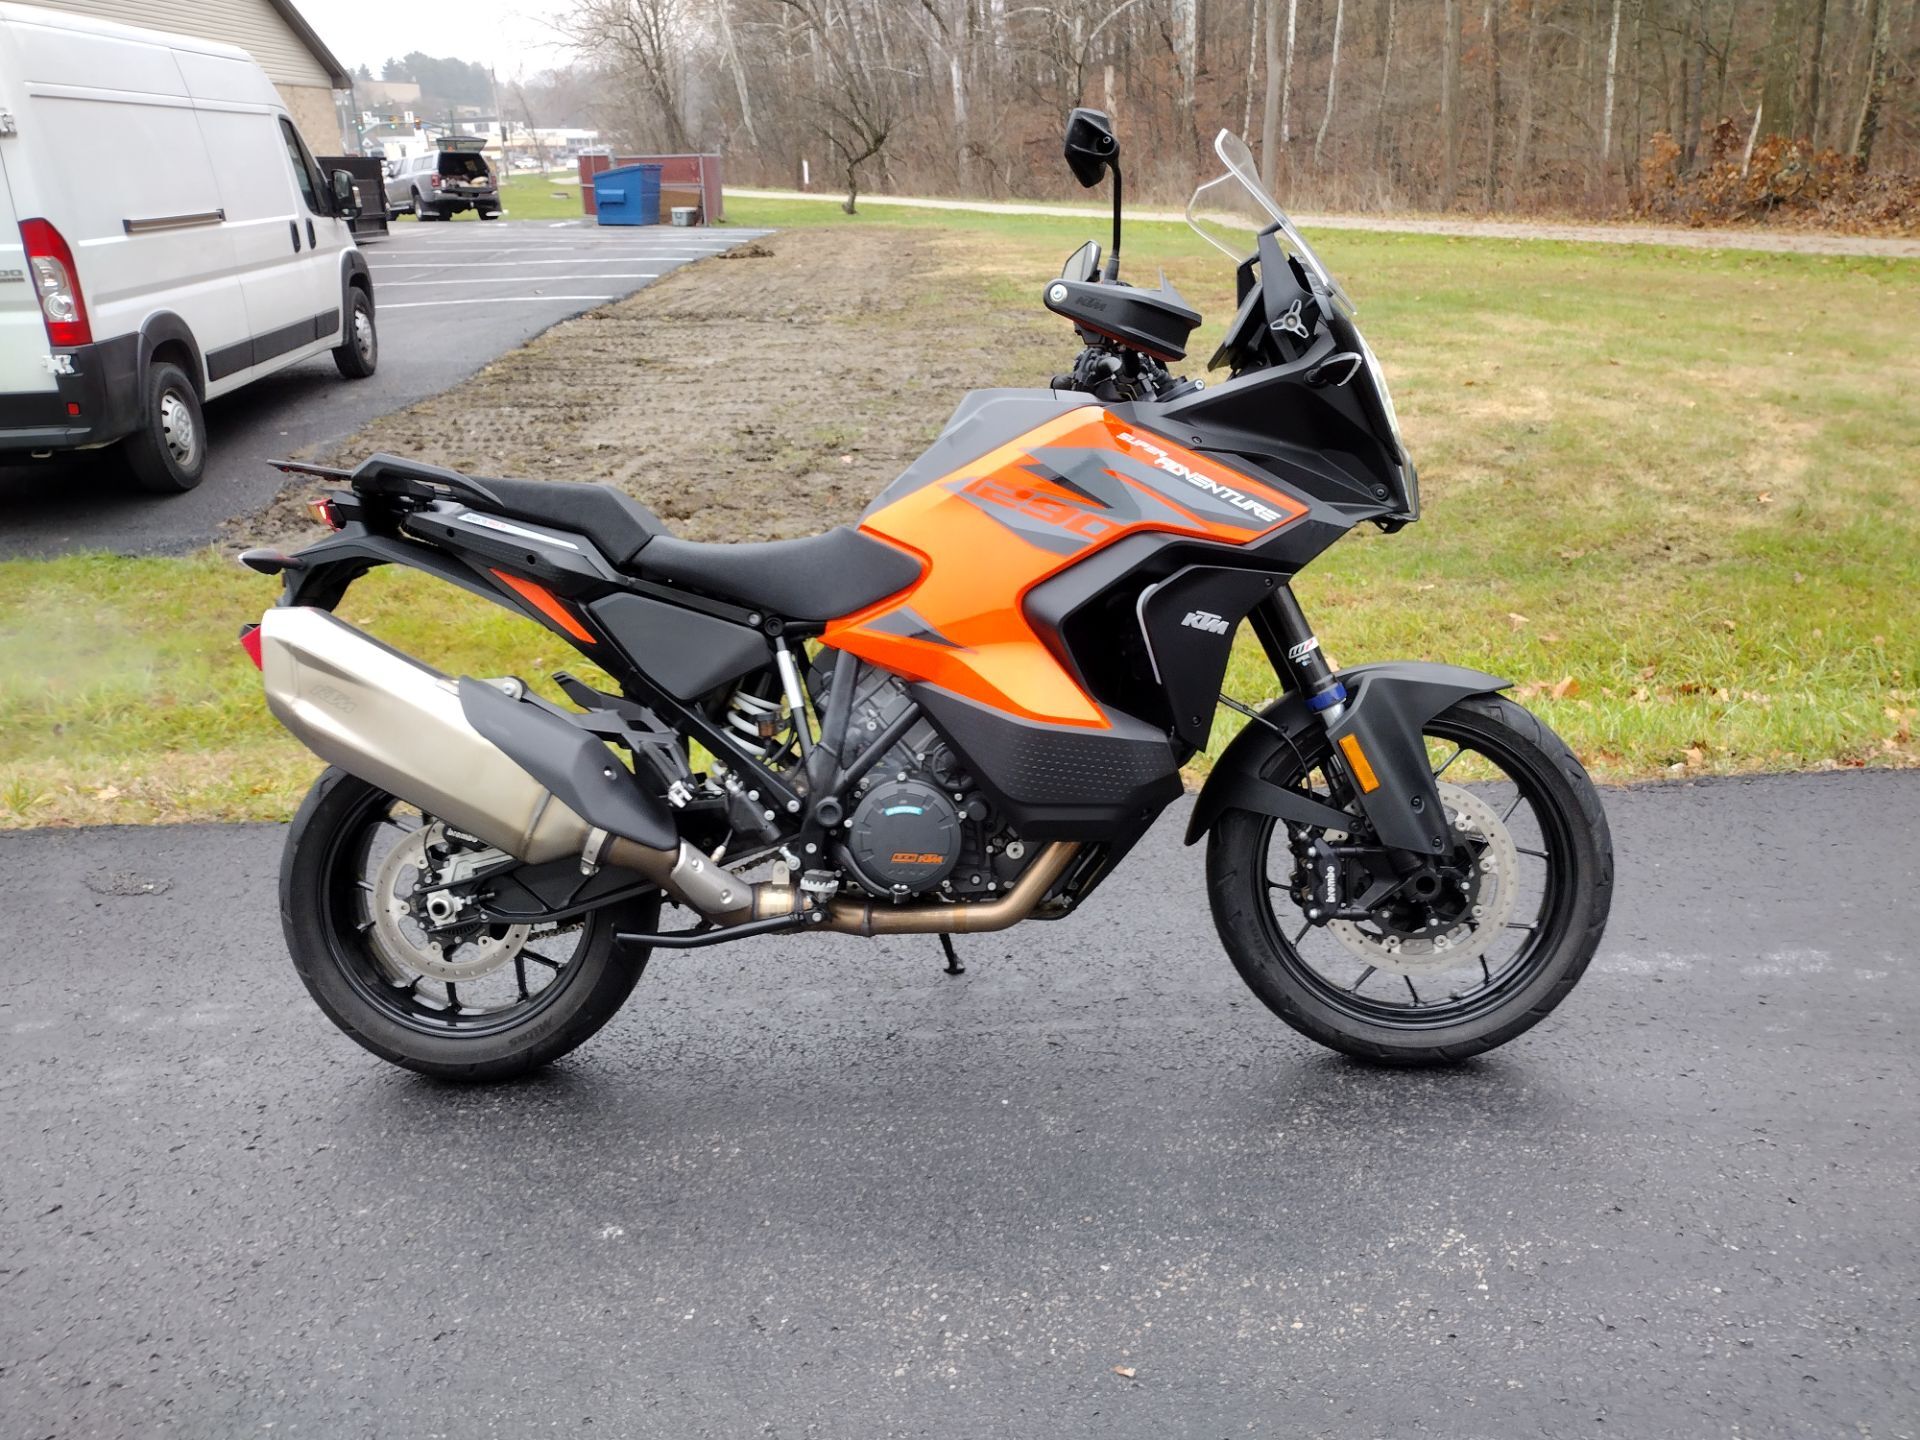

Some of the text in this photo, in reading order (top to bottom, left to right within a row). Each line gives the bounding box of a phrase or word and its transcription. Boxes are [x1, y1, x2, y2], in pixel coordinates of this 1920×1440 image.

[1116, 432, 1168, 458] SUPER
[1153, 456, 1282, 522] ADVENTURE
[1181, 610, 1230, 635] KTM
[1324, 865, 1336, 903] brembo
